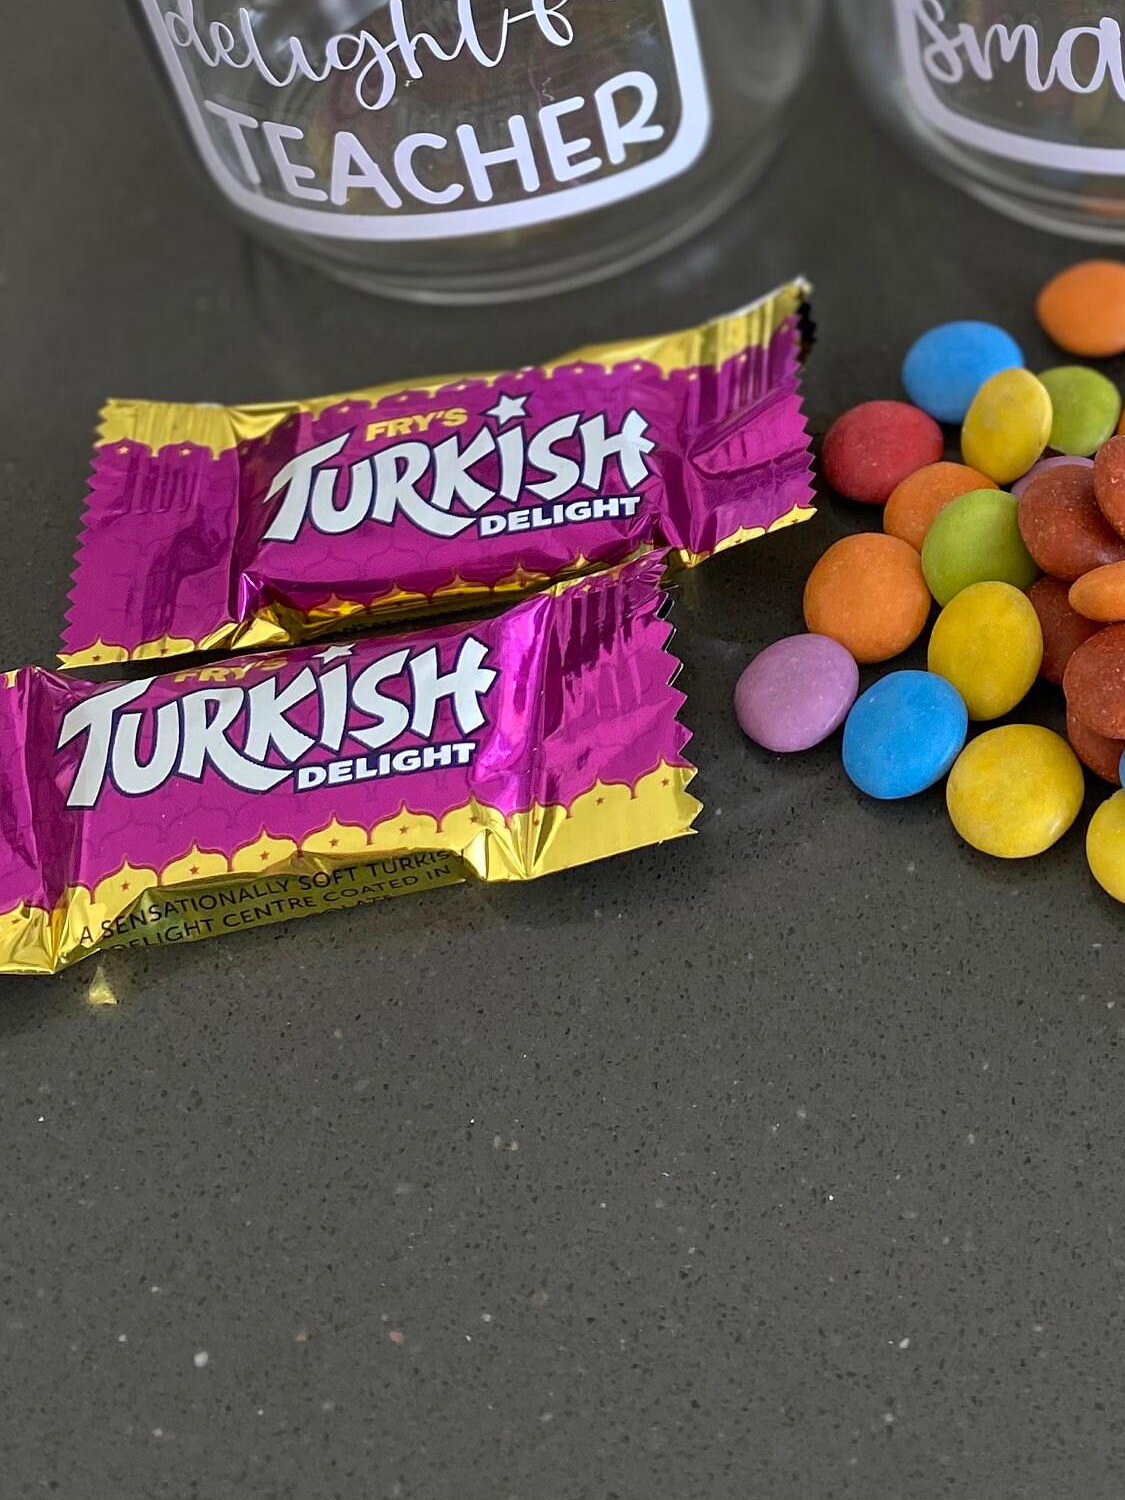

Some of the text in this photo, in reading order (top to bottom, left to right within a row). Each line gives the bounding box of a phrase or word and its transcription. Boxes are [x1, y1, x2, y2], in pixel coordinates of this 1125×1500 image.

[203, 70, 664, 207] TEACHER
[366, 406, 468, 442] FRY'S
[262, 394, 655, 542] TURKISH
[480, 496, 641, 535] DELIGHT
[57, 637, 498, 808] TURKISH
[297, 743, 476, 789] DELIGHT
[101, 879, 289, 939] SENSATIONALLY
[297, 866, 358, 891] SOFT
[222, 895, 317, 929] CENTRE
[323, 875, 419, 902] COATED
[427, 864, 451, 881] IN
